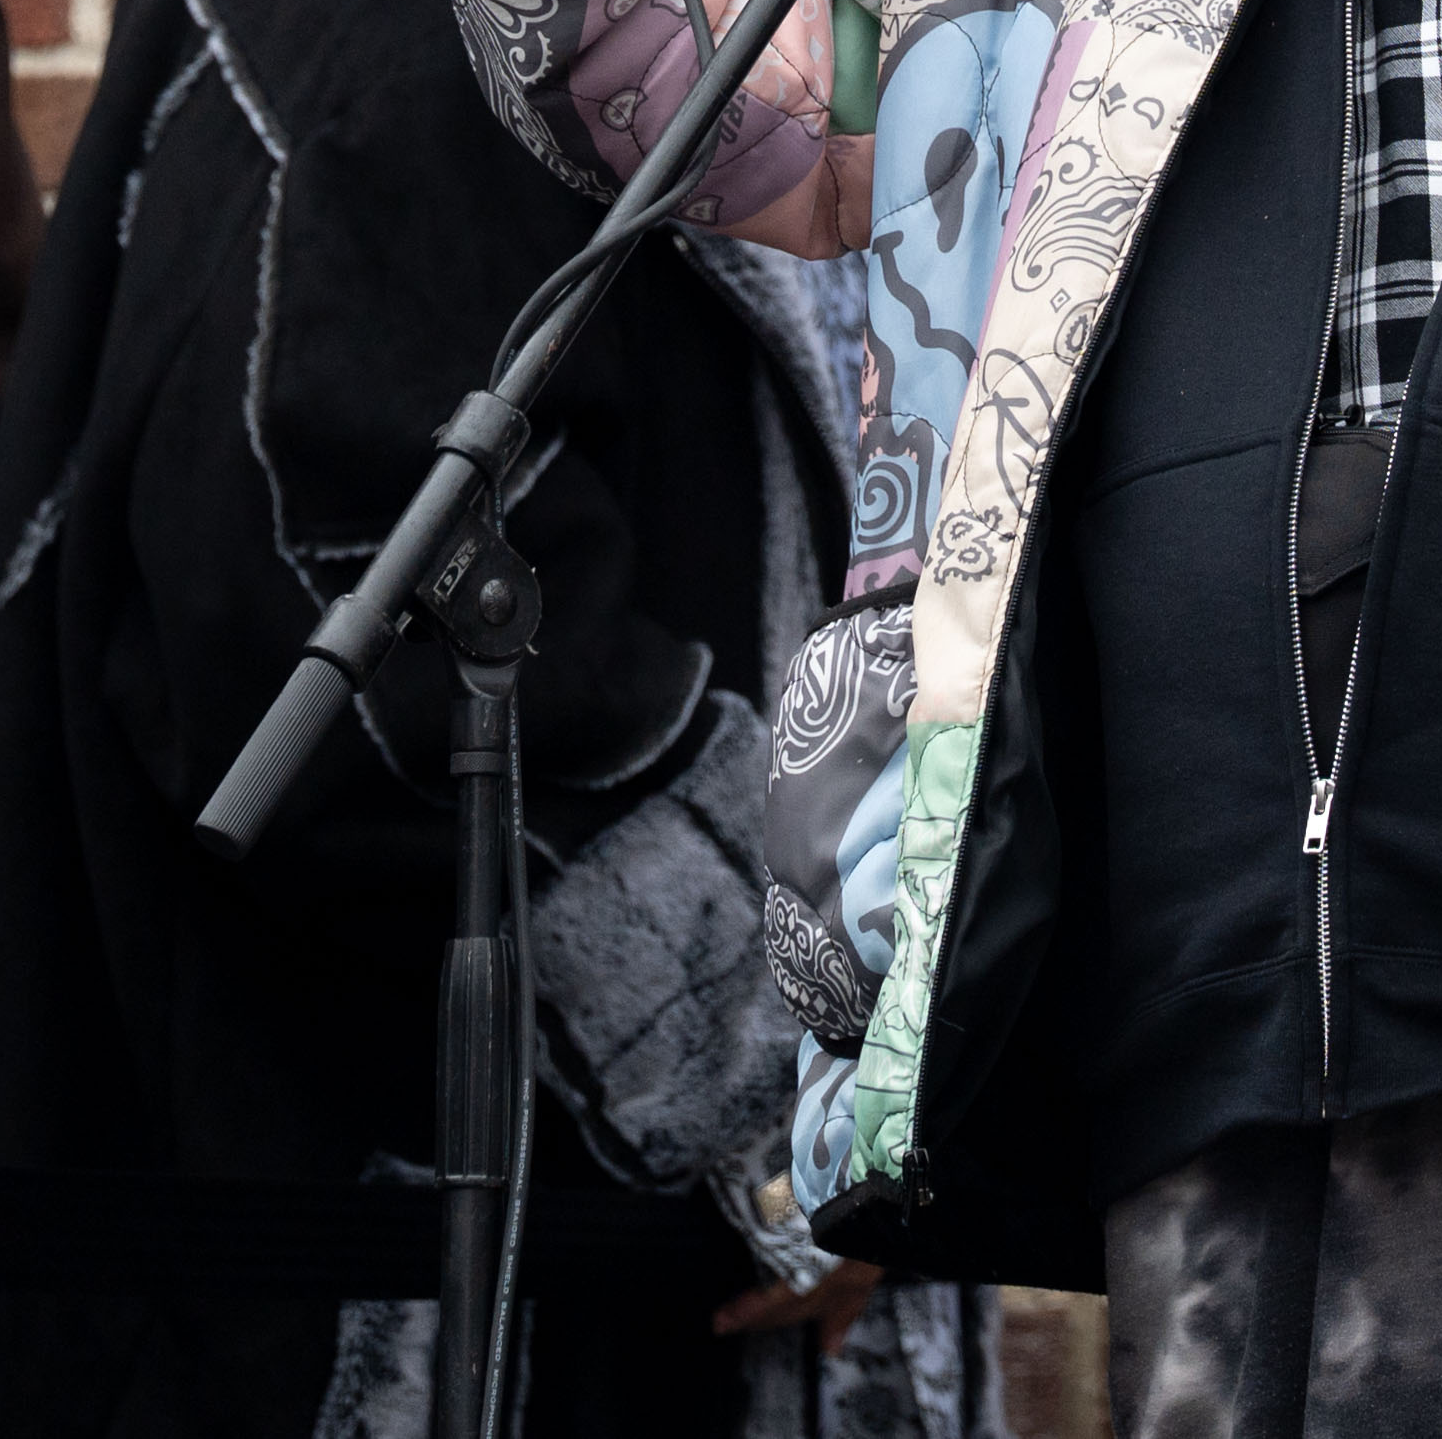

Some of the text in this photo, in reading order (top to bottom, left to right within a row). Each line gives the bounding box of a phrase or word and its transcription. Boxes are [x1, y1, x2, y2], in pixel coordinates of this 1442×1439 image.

[516, 1108, 529, 1192] PROFESSIONAL
[509, 1199, 521, 1248] BRAIDED
[502, 1254, 514, 1295] SHIELD
[495, 1301, 508, 1361] BALANCED
